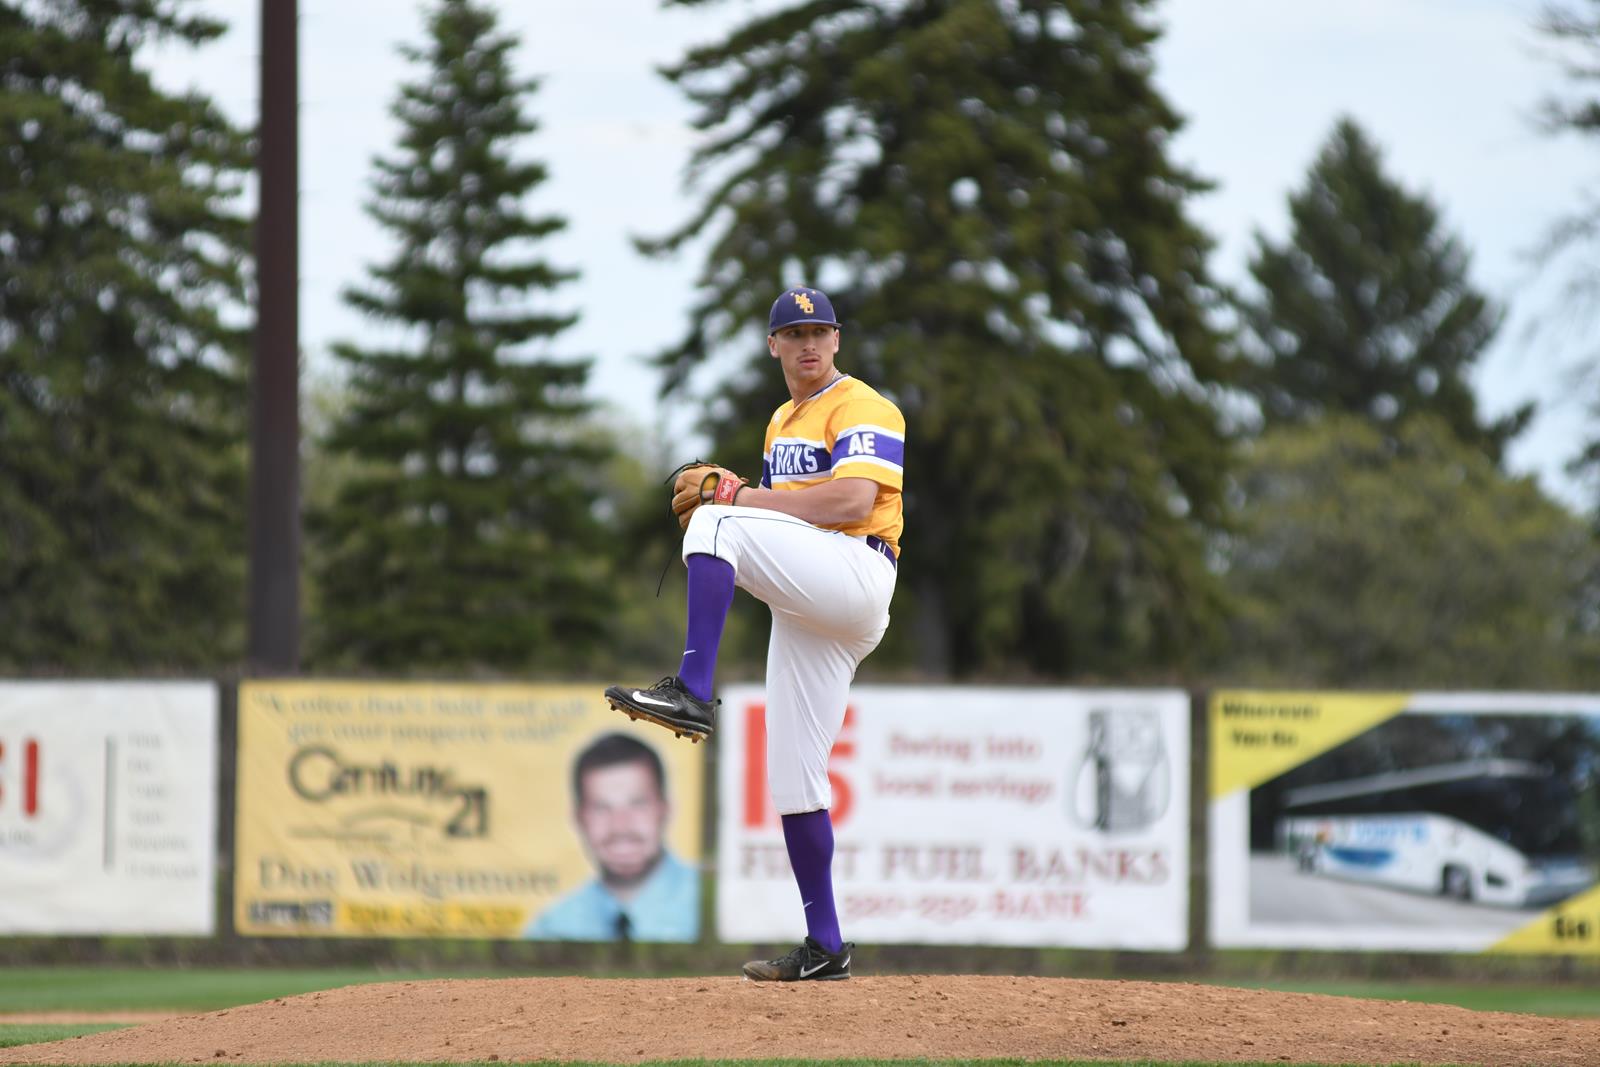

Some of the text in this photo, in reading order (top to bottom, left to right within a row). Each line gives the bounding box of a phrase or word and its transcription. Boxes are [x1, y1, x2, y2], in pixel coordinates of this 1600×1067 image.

[847, 431, 877, 456] AE
[288, 744, 453, 803] Century
[445, 787, 490, 838] 21
[880, 844, 996, 882] FUEL
[1009, 846, 1173, 884] BANKS
